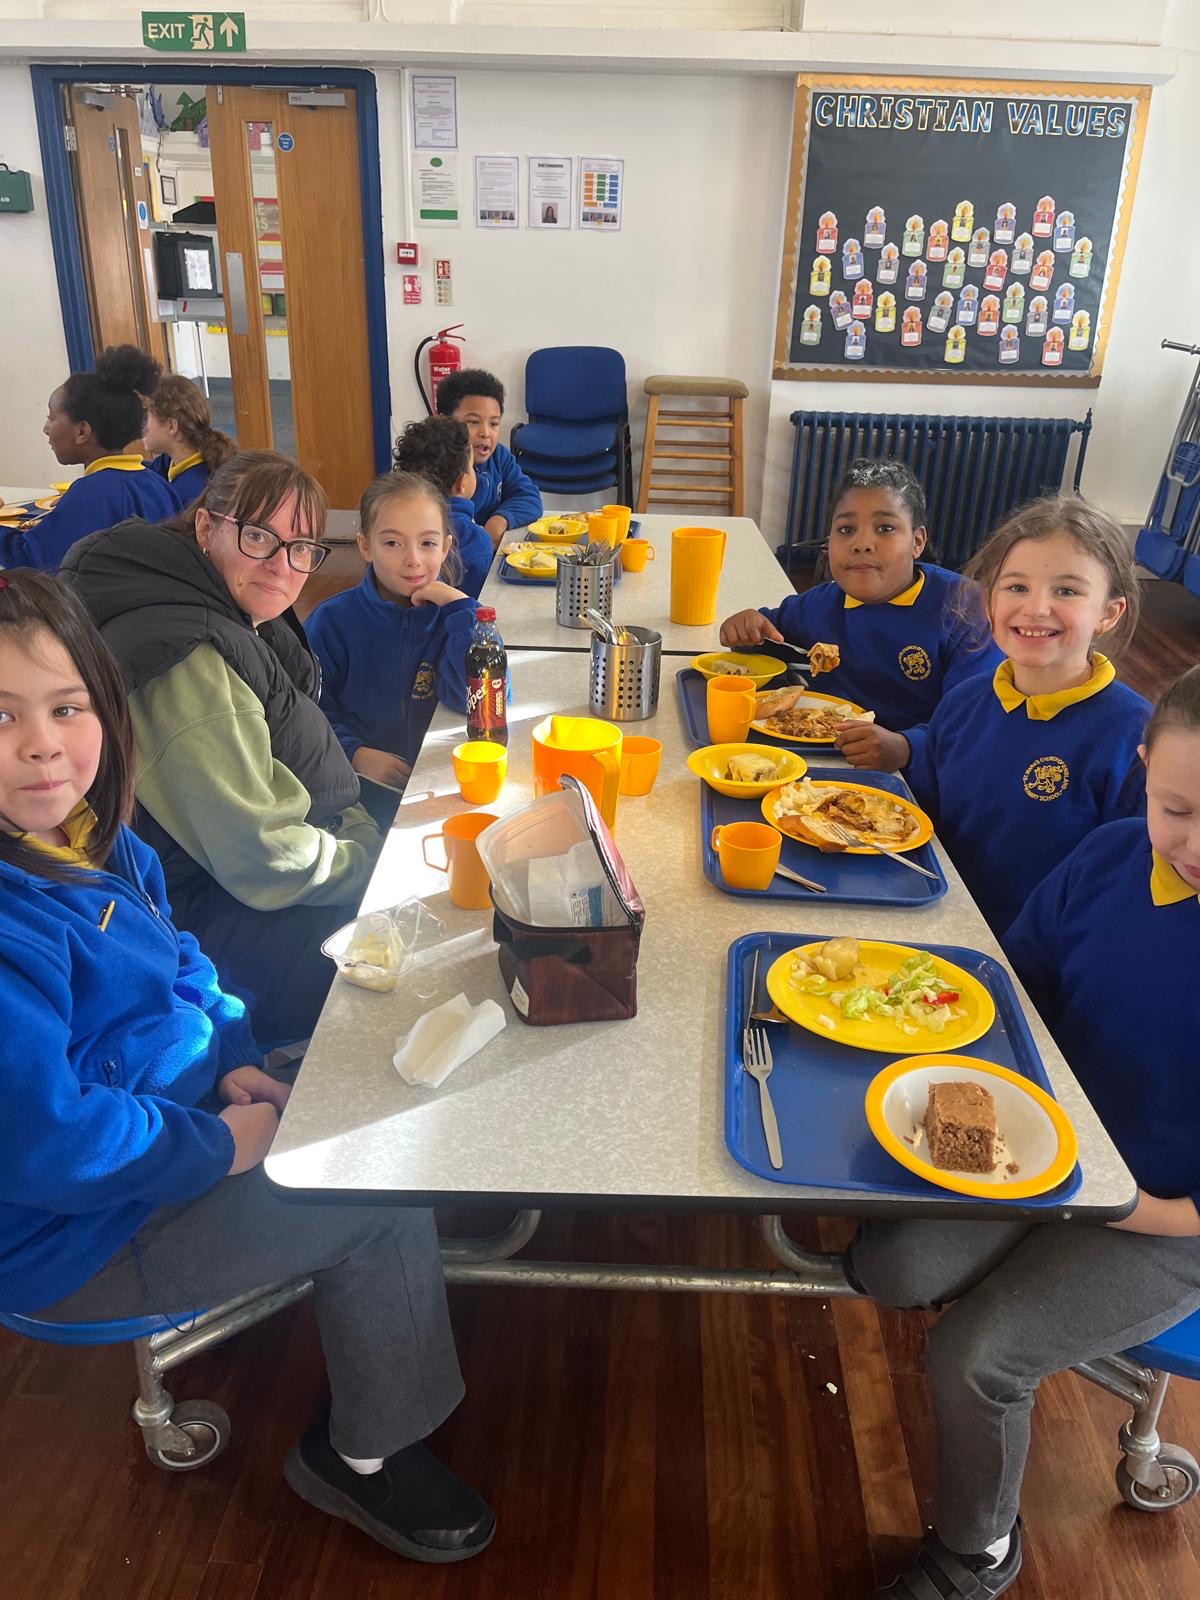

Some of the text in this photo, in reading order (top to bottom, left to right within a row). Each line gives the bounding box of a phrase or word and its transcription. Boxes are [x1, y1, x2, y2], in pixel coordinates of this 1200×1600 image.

[147, 23, 185, 39] EXIT
[815, 95, 1126, 138] CHRISTIAN VALUES
